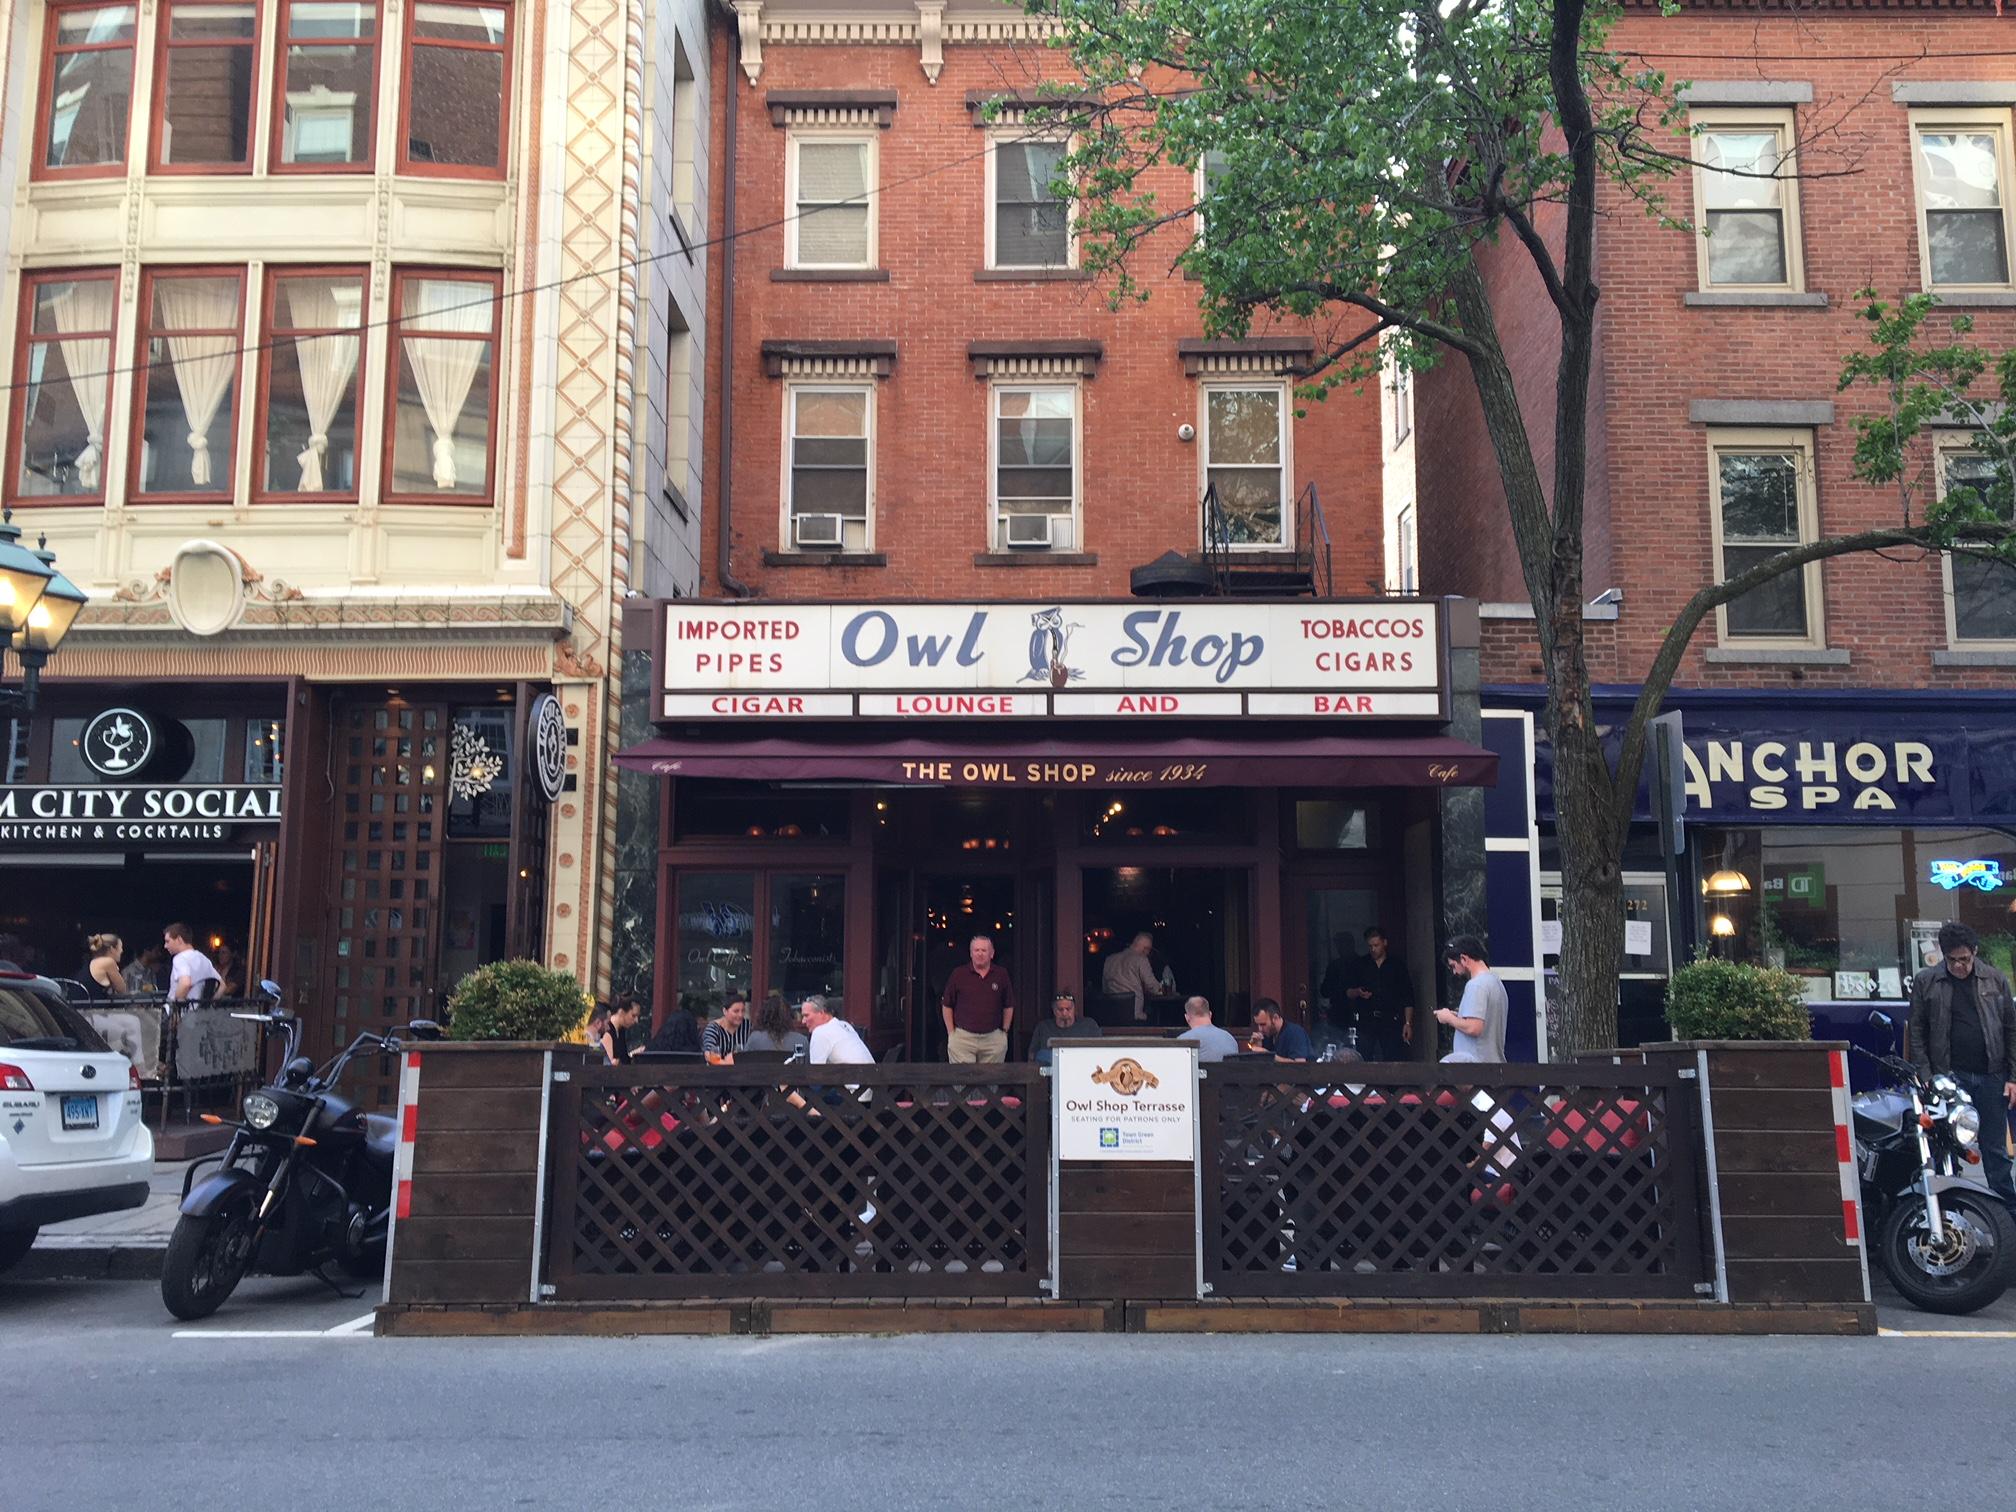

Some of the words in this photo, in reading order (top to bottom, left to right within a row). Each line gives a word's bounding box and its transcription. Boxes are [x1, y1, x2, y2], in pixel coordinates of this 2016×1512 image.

[678, 620, 800, 640] IMPORTED
[1300, 619, 1424, 639] TOBACCOS
[841, 610, 988, 667] Owl
[1110, 610, 1265, 684] Shop
[696, 653, 783, 673] PIPES
[1315, 652, 1413, 672] CIGARS
[711, 697, 805, 713] CIGAR
[896, 696, 1013, 713] LOUNGE
[1117, 696, 1179, 713] AND
[1314, 695, 1373, 713] BAR
[902, 763, 952, 780] THE
[963, 763, 1016, 782] OWL
[1027, 763, 1097, 782] SHOP
[1105, 766, 1154, 783] since
[1160, 764, 1207, 782] 1934
[1427, 763, 1459, 782] Cafe
[32, 790, 132, 817] CITY
[143, 789, 282, 817] SOCIAL
[1750, 786, 1897, 809] SPA
[1, 825, 82, 839] KITCHEN
[94, 825, 104, 839] &
[117, 824, 222, 839] COCKTAILS
[1627, 900, 1649, 911] 272
[1066, 1100, 1092, 1111] Owl
[1096, 1100, 1129, 1114] Shop
[1132, 1100, 1186, 1112] Terrasse
